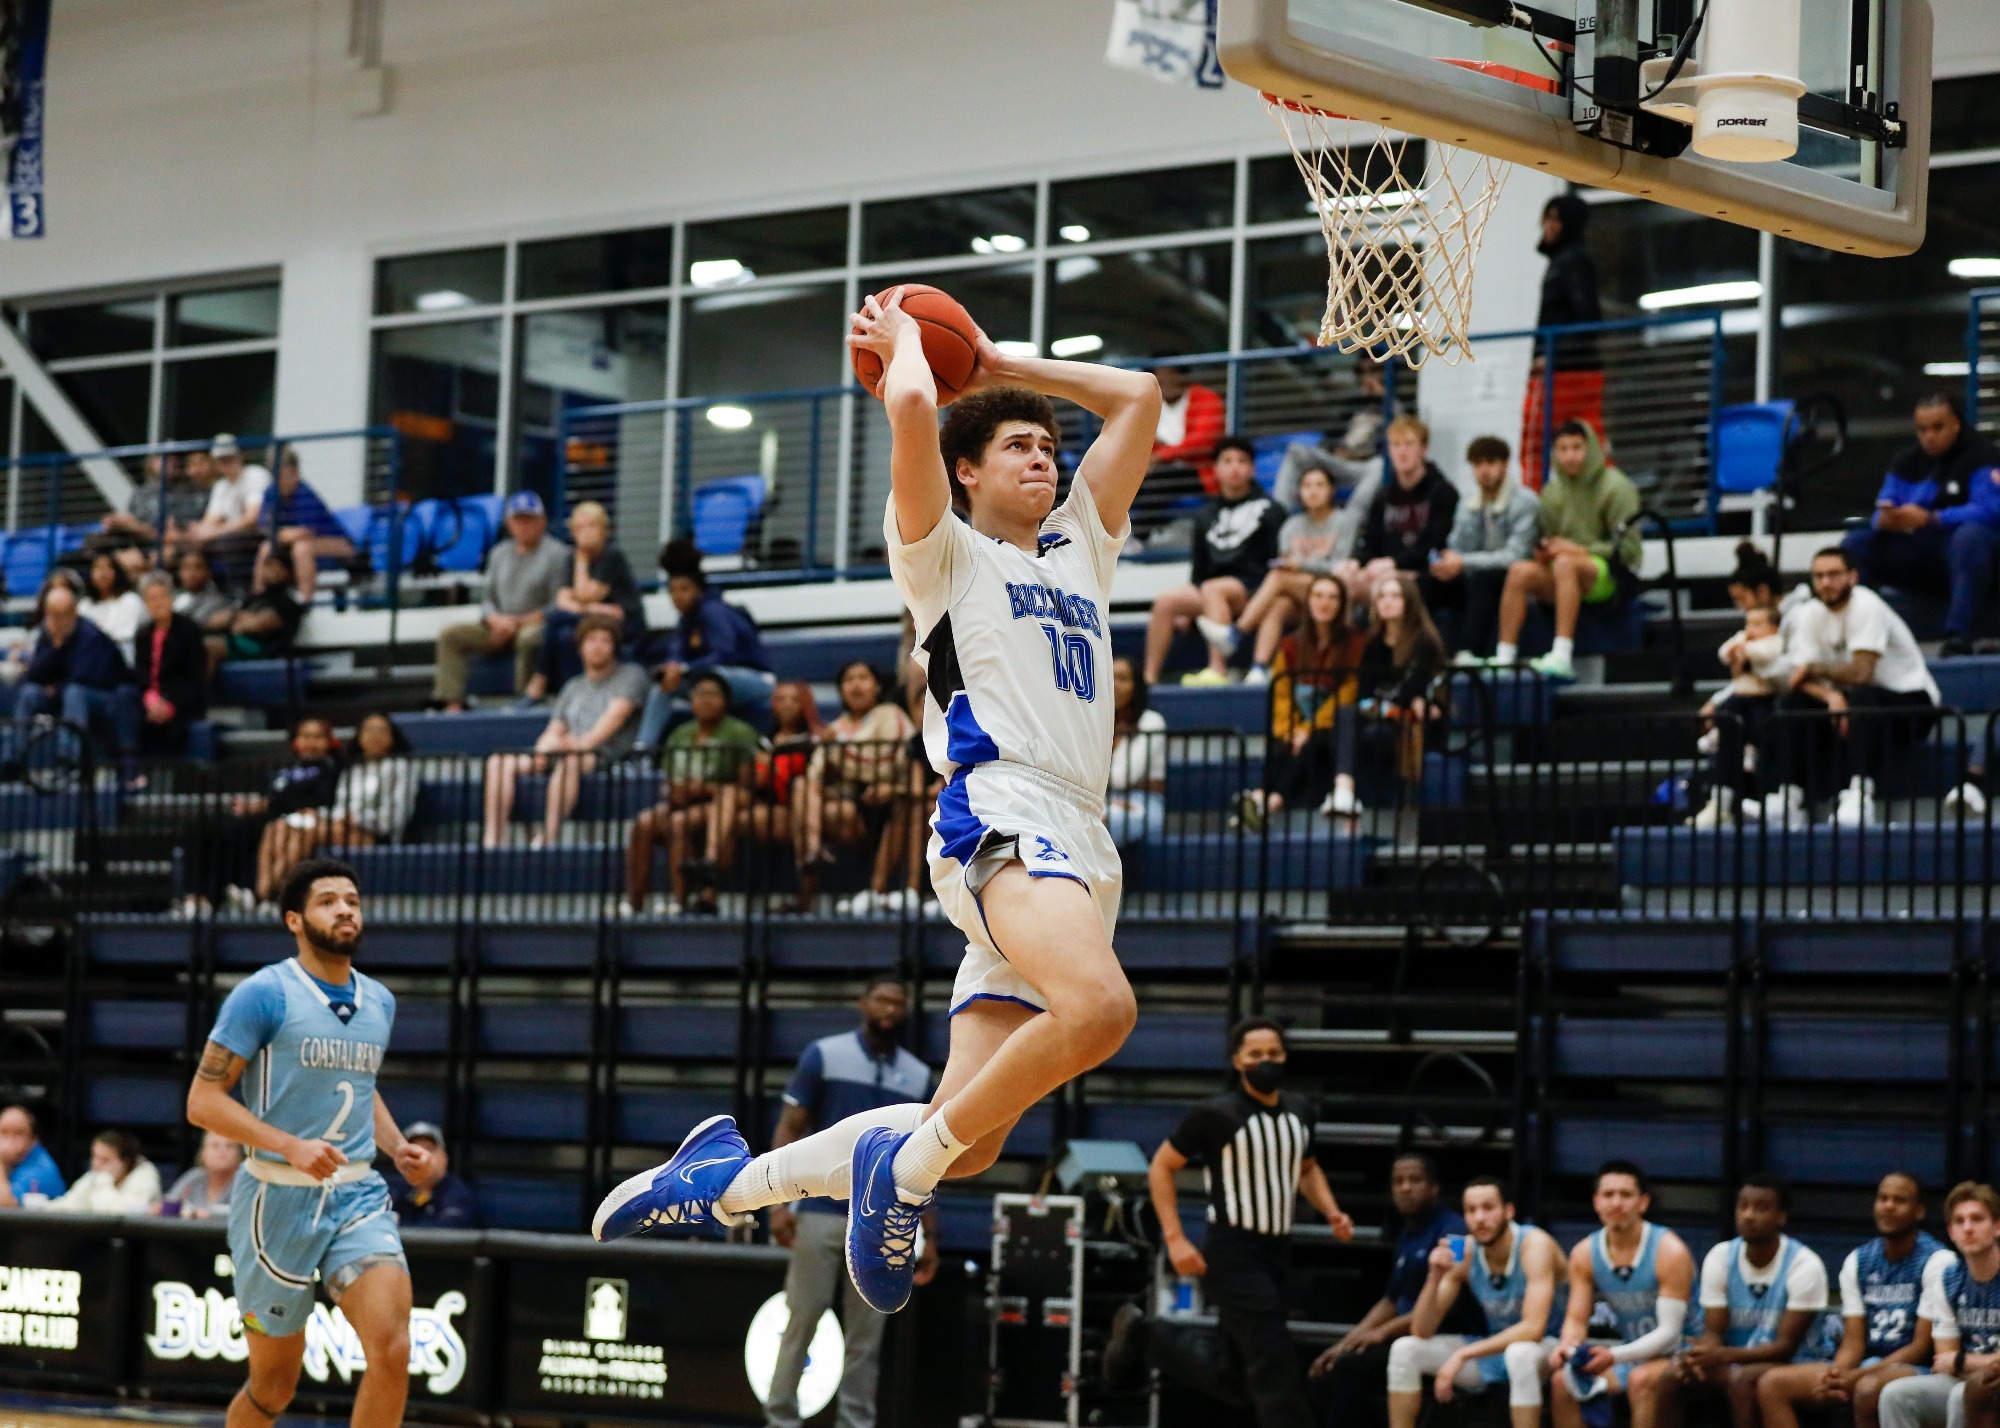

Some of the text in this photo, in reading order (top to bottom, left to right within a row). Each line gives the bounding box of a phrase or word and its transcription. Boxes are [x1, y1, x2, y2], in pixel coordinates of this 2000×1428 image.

[1040, 622, 1095, 703] 10
[301, 1036, 352, 1070] COASTAL
[320, 1080, 355, 1141] 2
